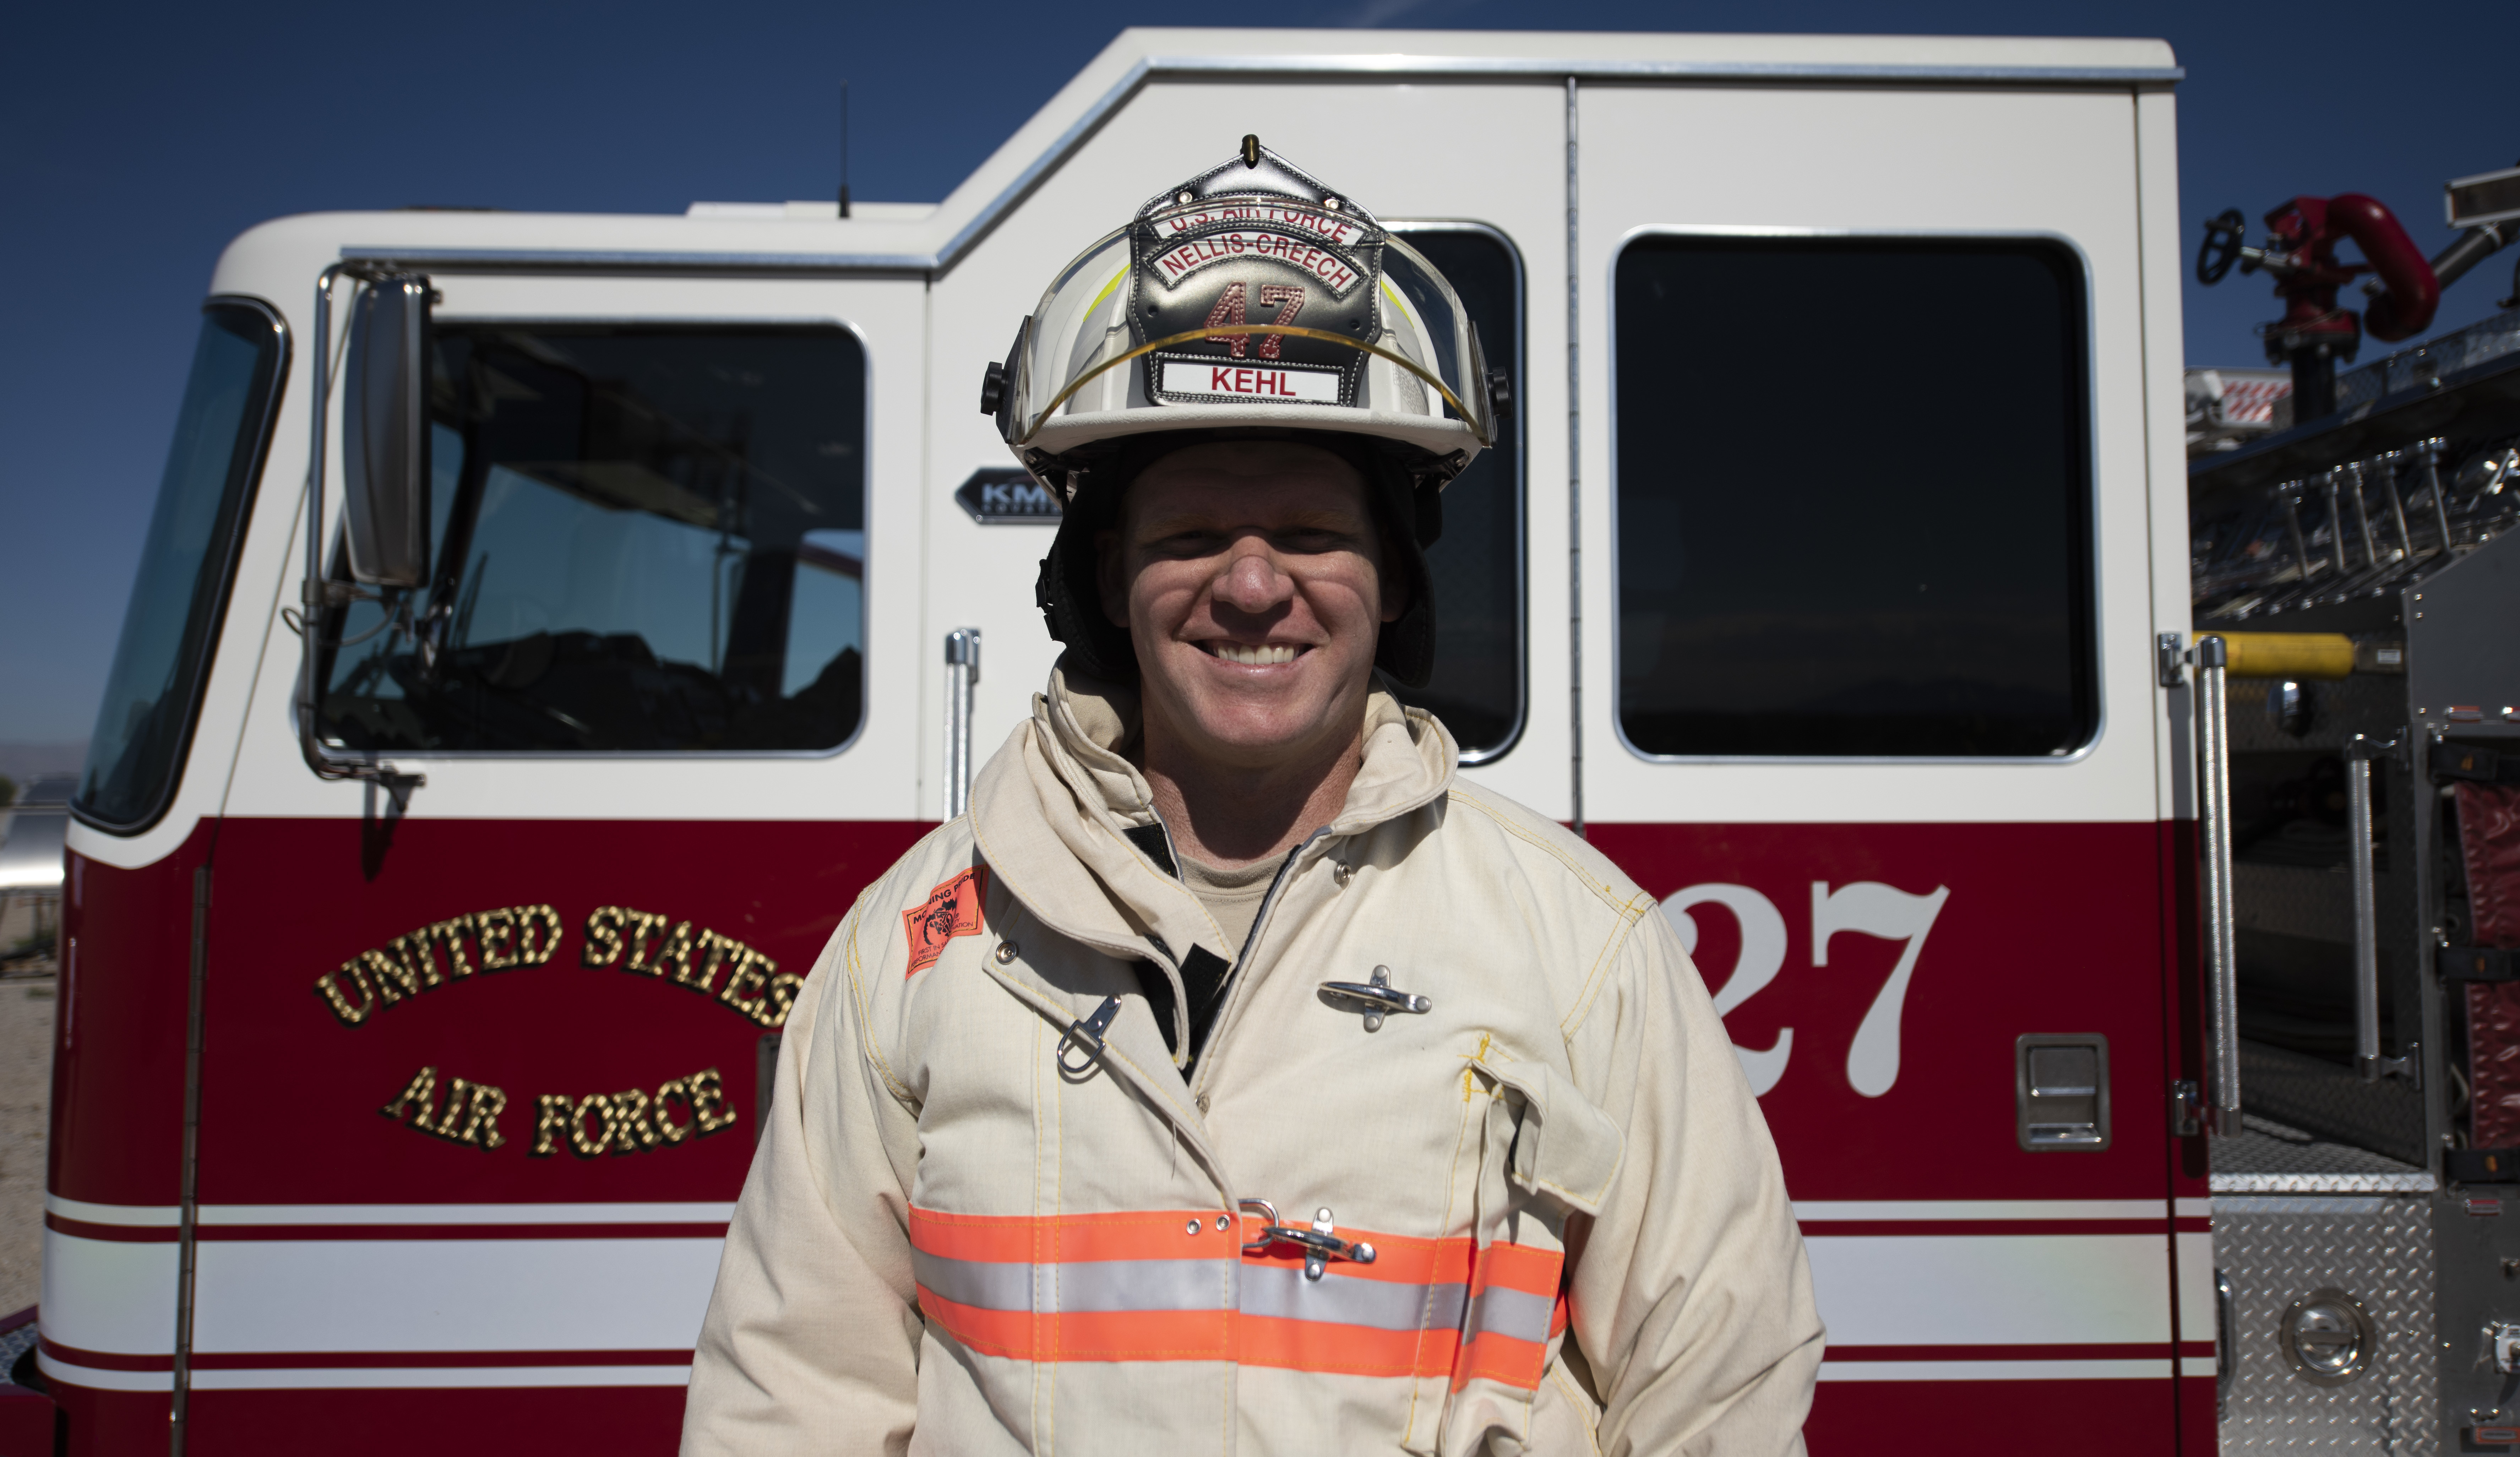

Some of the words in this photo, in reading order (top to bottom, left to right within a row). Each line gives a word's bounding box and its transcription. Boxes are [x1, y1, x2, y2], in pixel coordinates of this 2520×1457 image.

[1161, 233, 1353, 288] NELLIS-CREECH
[1203, 281, 1305, 359] 47
[1211, 366, 1296, 396] KEHL
[981, 483, 1052, 504] KM
[954, 872, 975, 892] PRIDE
[313, 904, 562, 1030] UNITED
[580, 905, 805, 1028] STATES
[918, 946, 931, 956] FIRST
[1657, 880, 1951, 1098] 27
[377, 1065, 507, 1153] AIR
[527, 1065, 737, 1159] FORCE
